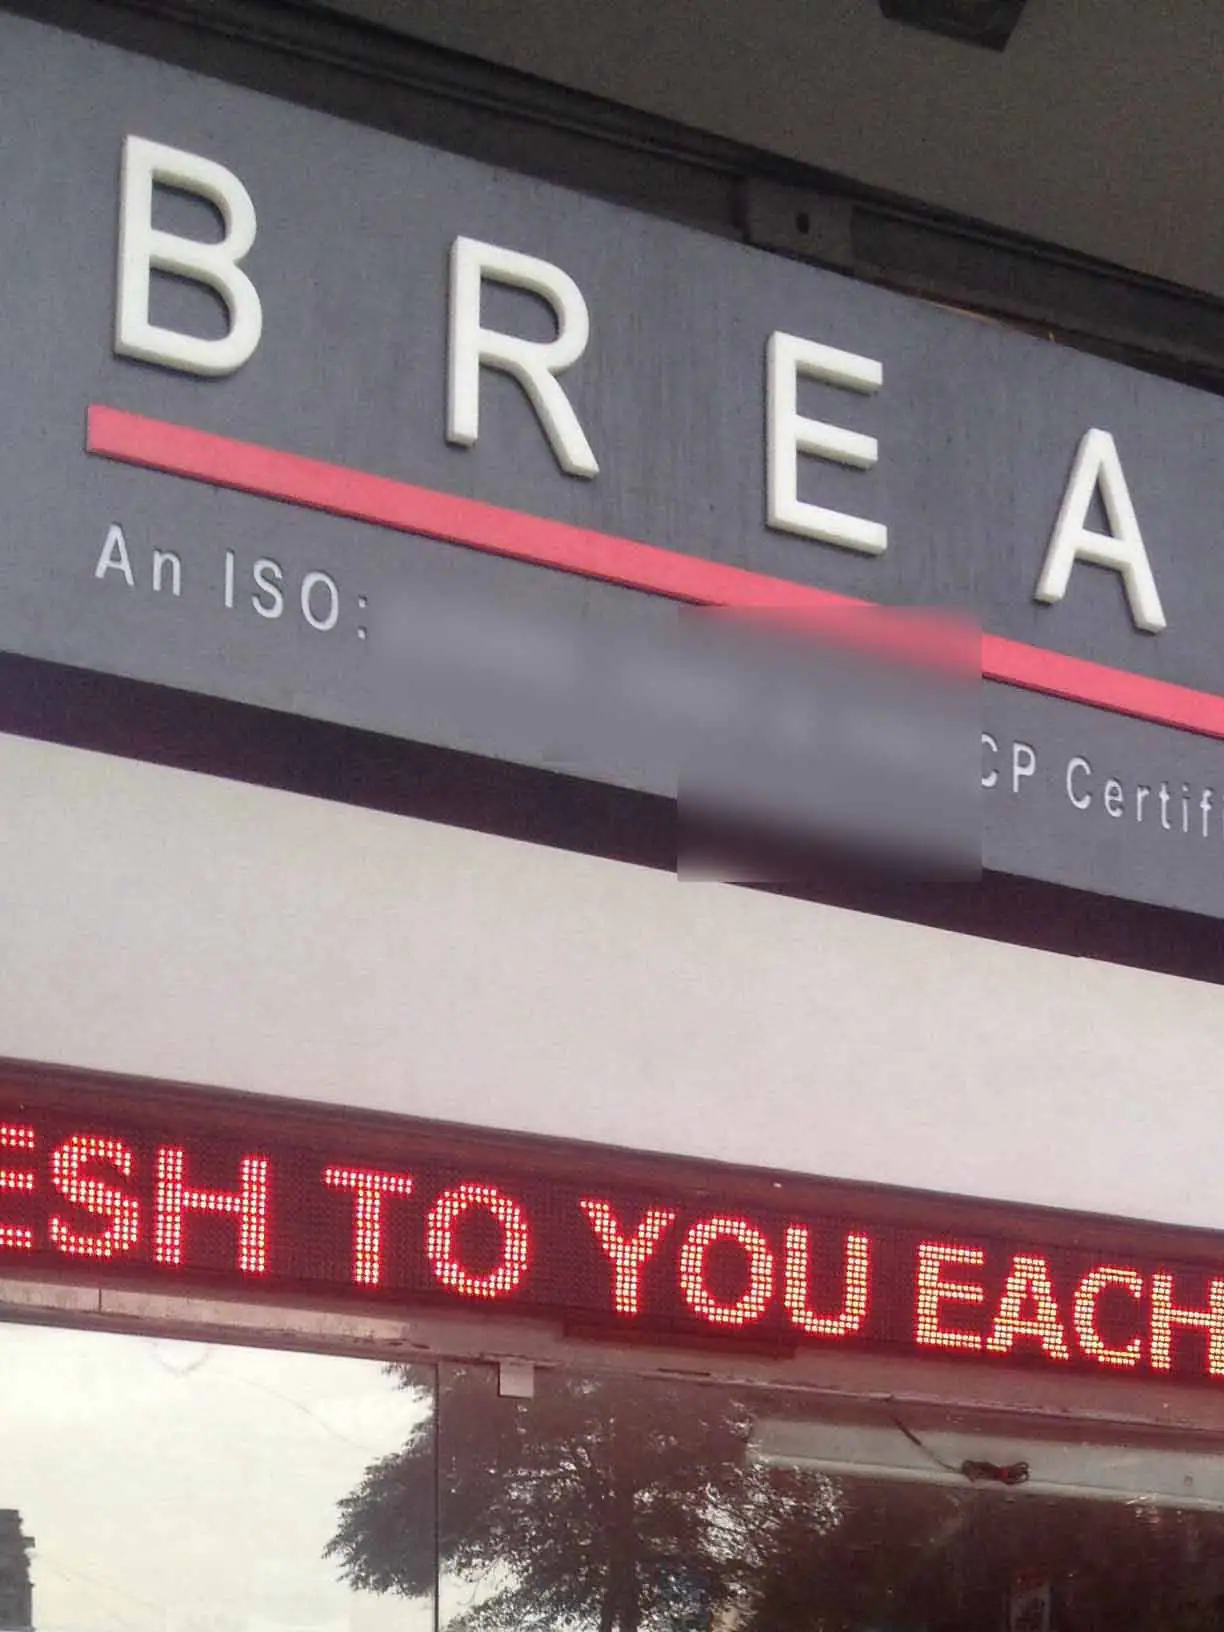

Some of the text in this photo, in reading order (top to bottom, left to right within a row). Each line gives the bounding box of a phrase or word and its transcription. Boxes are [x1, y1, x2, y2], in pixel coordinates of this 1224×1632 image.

[94, 523, 182, 597] An
[324, 1166, 530, 1299] TO
[580, 1198, 869, 1336] YOU
